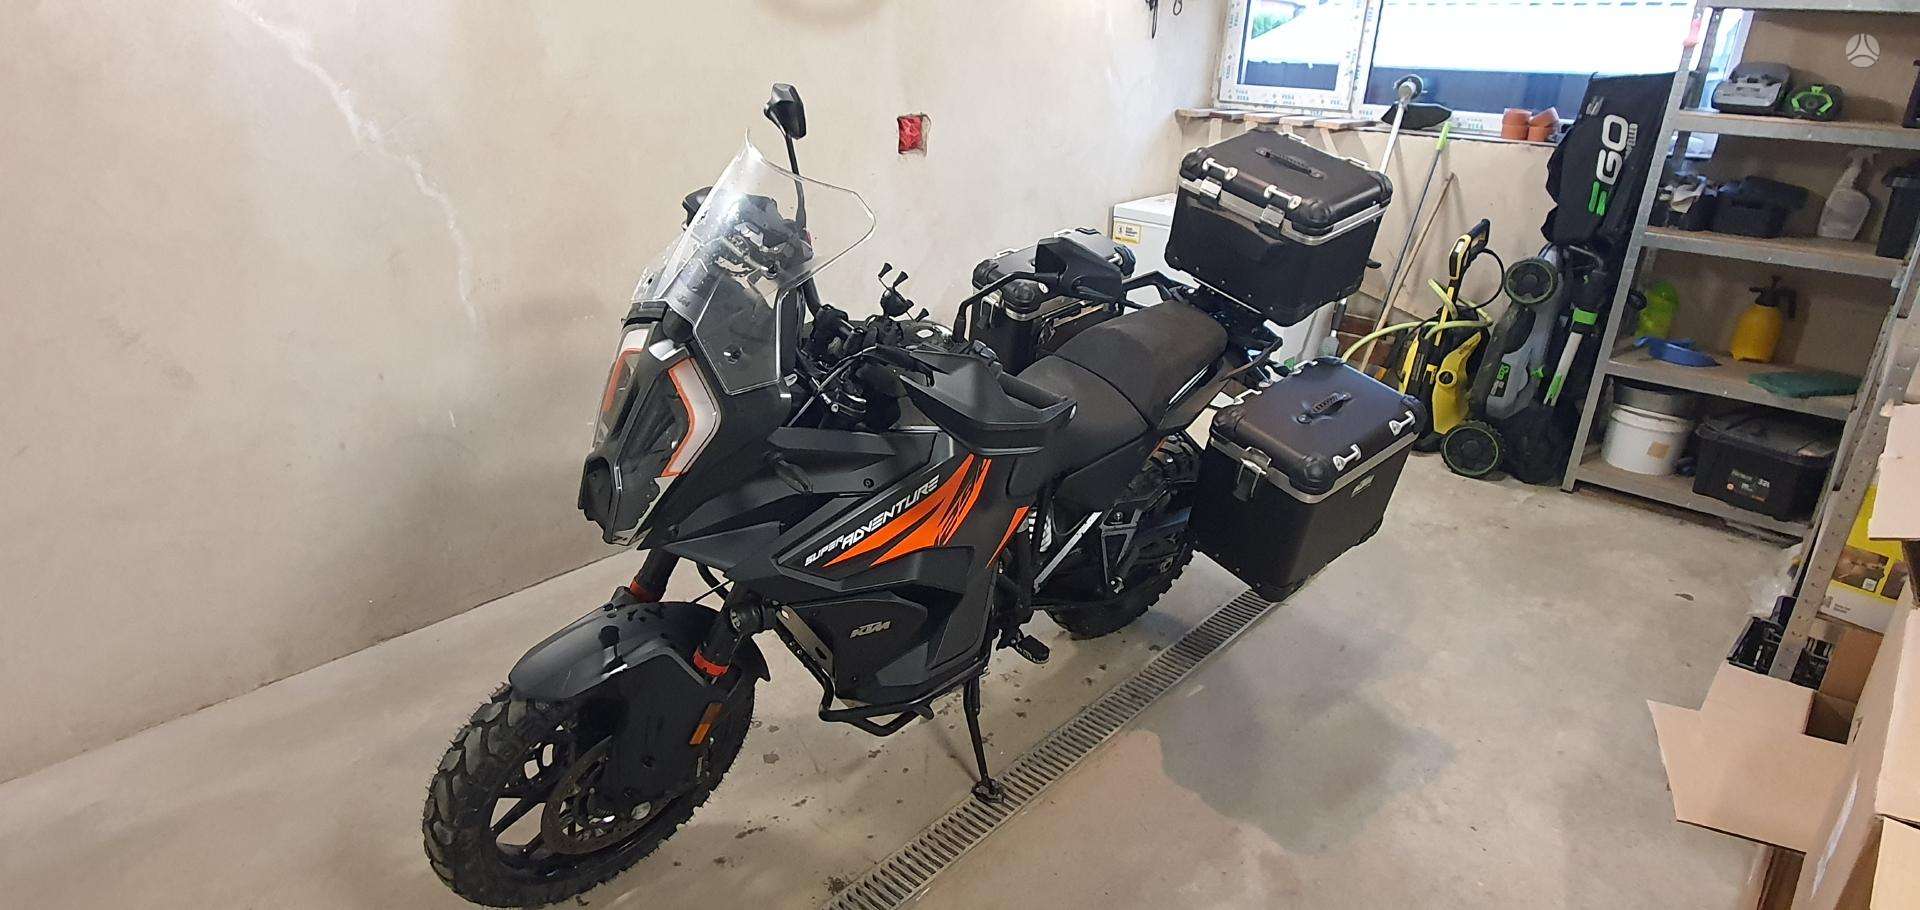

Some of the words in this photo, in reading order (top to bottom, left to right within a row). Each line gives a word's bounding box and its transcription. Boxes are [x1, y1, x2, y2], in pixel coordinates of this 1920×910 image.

[1588, 114, 1629, 216] EGO
[804, 535, 844, 567] SUPER
[841, 474, 940, 550] ADVENTURE
[849, 620, 891, 639] KTM
